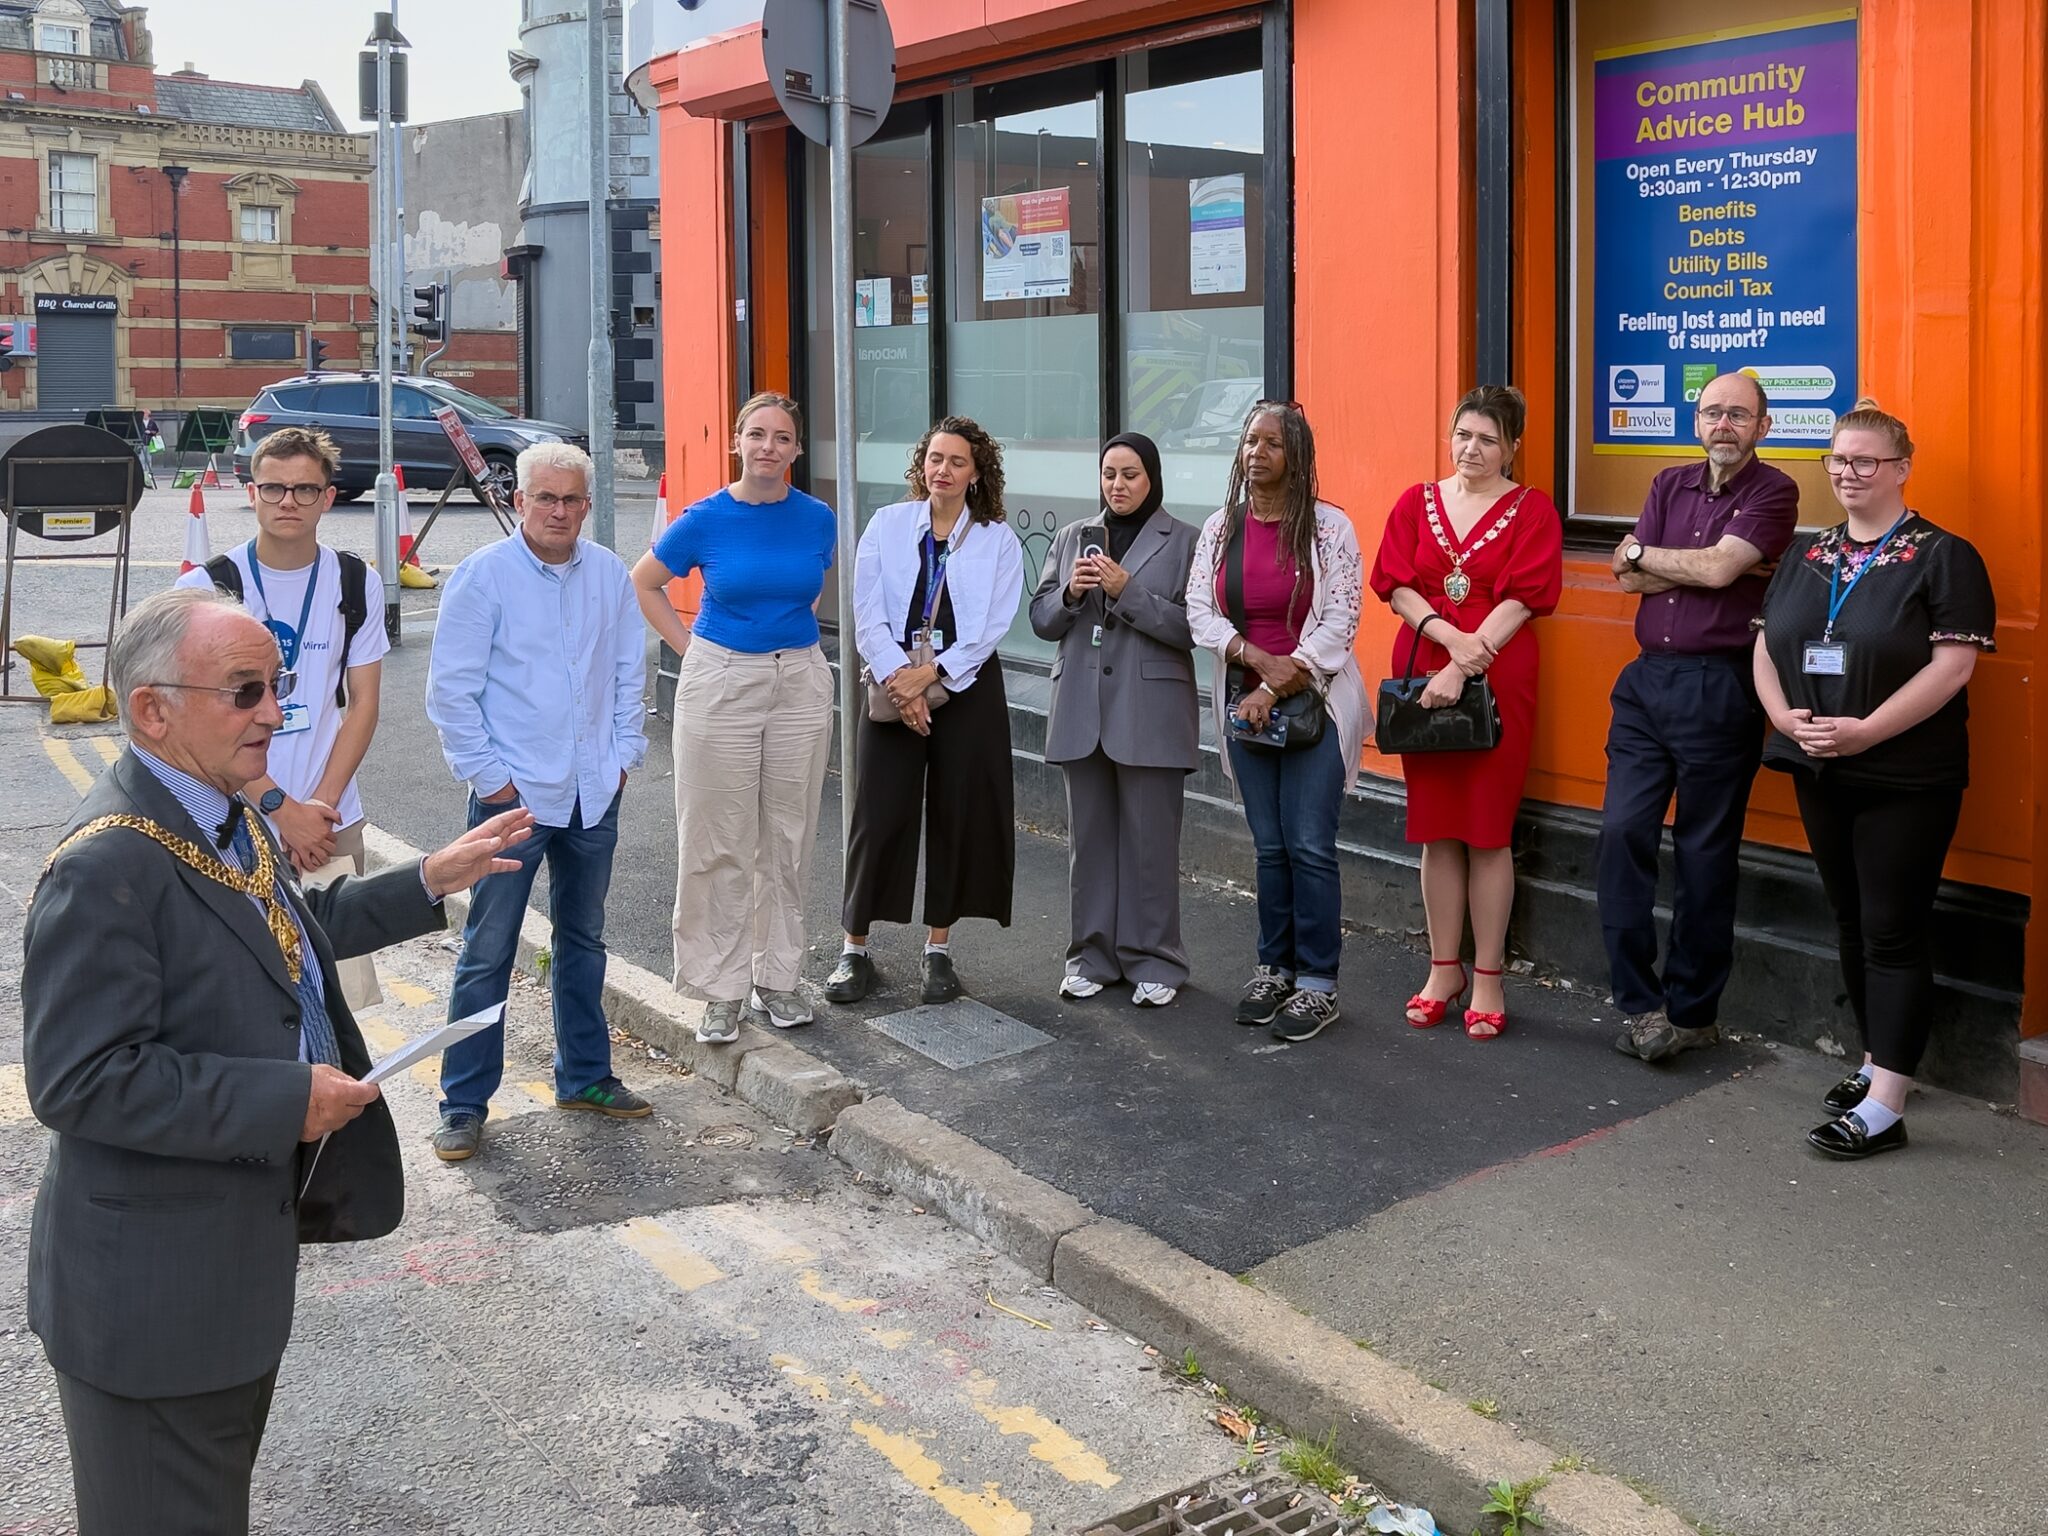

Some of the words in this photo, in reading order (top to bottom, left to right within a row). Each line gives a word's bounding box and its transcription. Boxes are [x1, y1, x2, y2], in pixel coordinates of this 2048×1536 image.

[1636, 63, 1806, 107] Community
[1636, 111, 1733, 143] Advice
[1743, 98, 1805, 130] Hub
[1626, 163, 1670, 181] Open
[1675, 157, 1724, 175] Every
[1729, 146, 1818, 168] Thursday
[1639, 179, 1702, 198] 9:30am
[1721, 169, 1801, 190] 12:30pm
[1679, 201, 1757, 222] Benefits
[1690, 229, 1745, 248] Debts
[1669, 255, 1720, 276] Utility
[1727, 252, 1768, 271] Bills
[1664, 280, 1733, 300] Council
[1740, 278, 1773, 297] Tax
[38, 299, 57, 310] BBQ
[62, 300, 95, 309] Charcoal
[96, 301, 116, 310] Grills
[1619, 312, 1678, 334] Feeling
[1682, 310, 1714, 329] lost
[1719, 309, 1751, 328] and
[1758, 308, 1774, 327] in
[1781, 306, 1825, 326] need
[1668, 332, 1685, 350] of
[1690, 328, 1768, 353] support?
[1616, 411, 1672, 428] involve
[1784, 414, 1830, 425] CHANGE
